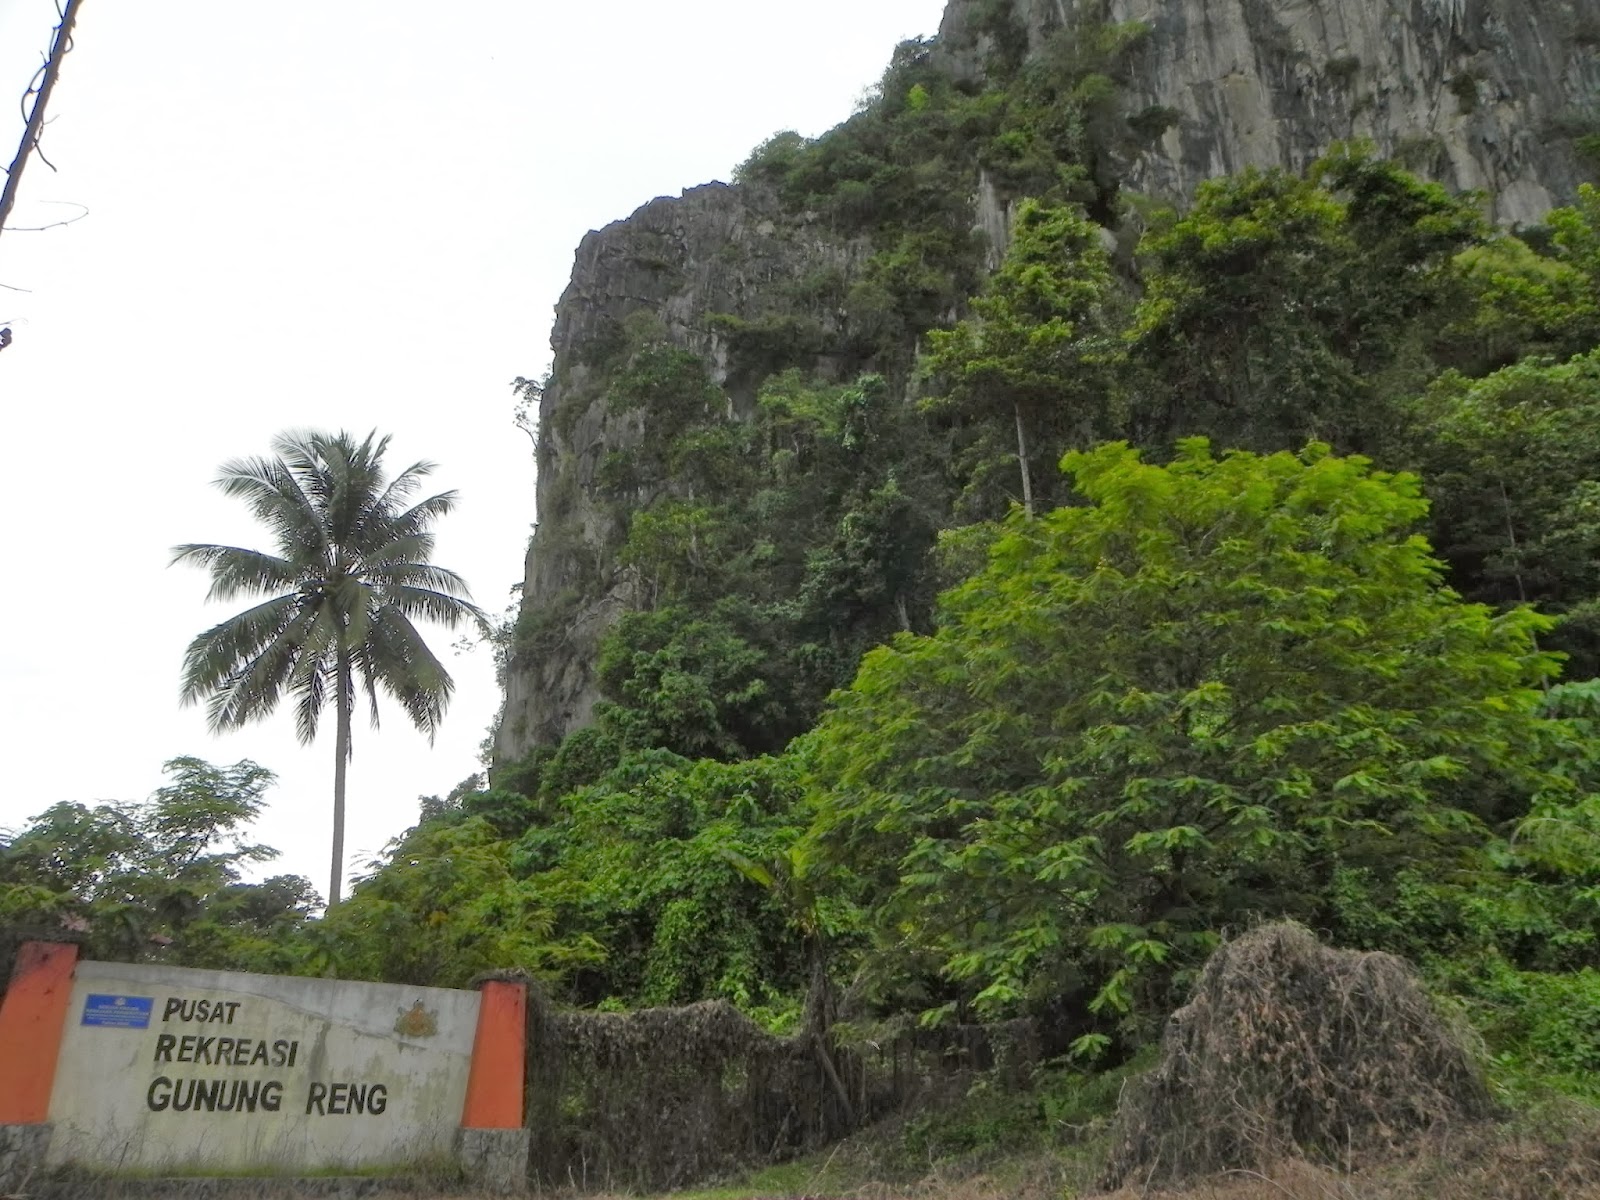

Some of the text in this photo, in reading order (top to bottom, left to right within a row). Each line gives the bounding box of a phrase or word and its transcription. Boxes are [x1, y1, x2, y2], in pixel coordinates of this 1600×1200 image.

[162, 997, 241, 1024] PUSAT
[153, 1034, 299, 1068] REKREASI
[147, 1076, 388, 1116] GUNUNG RENG
